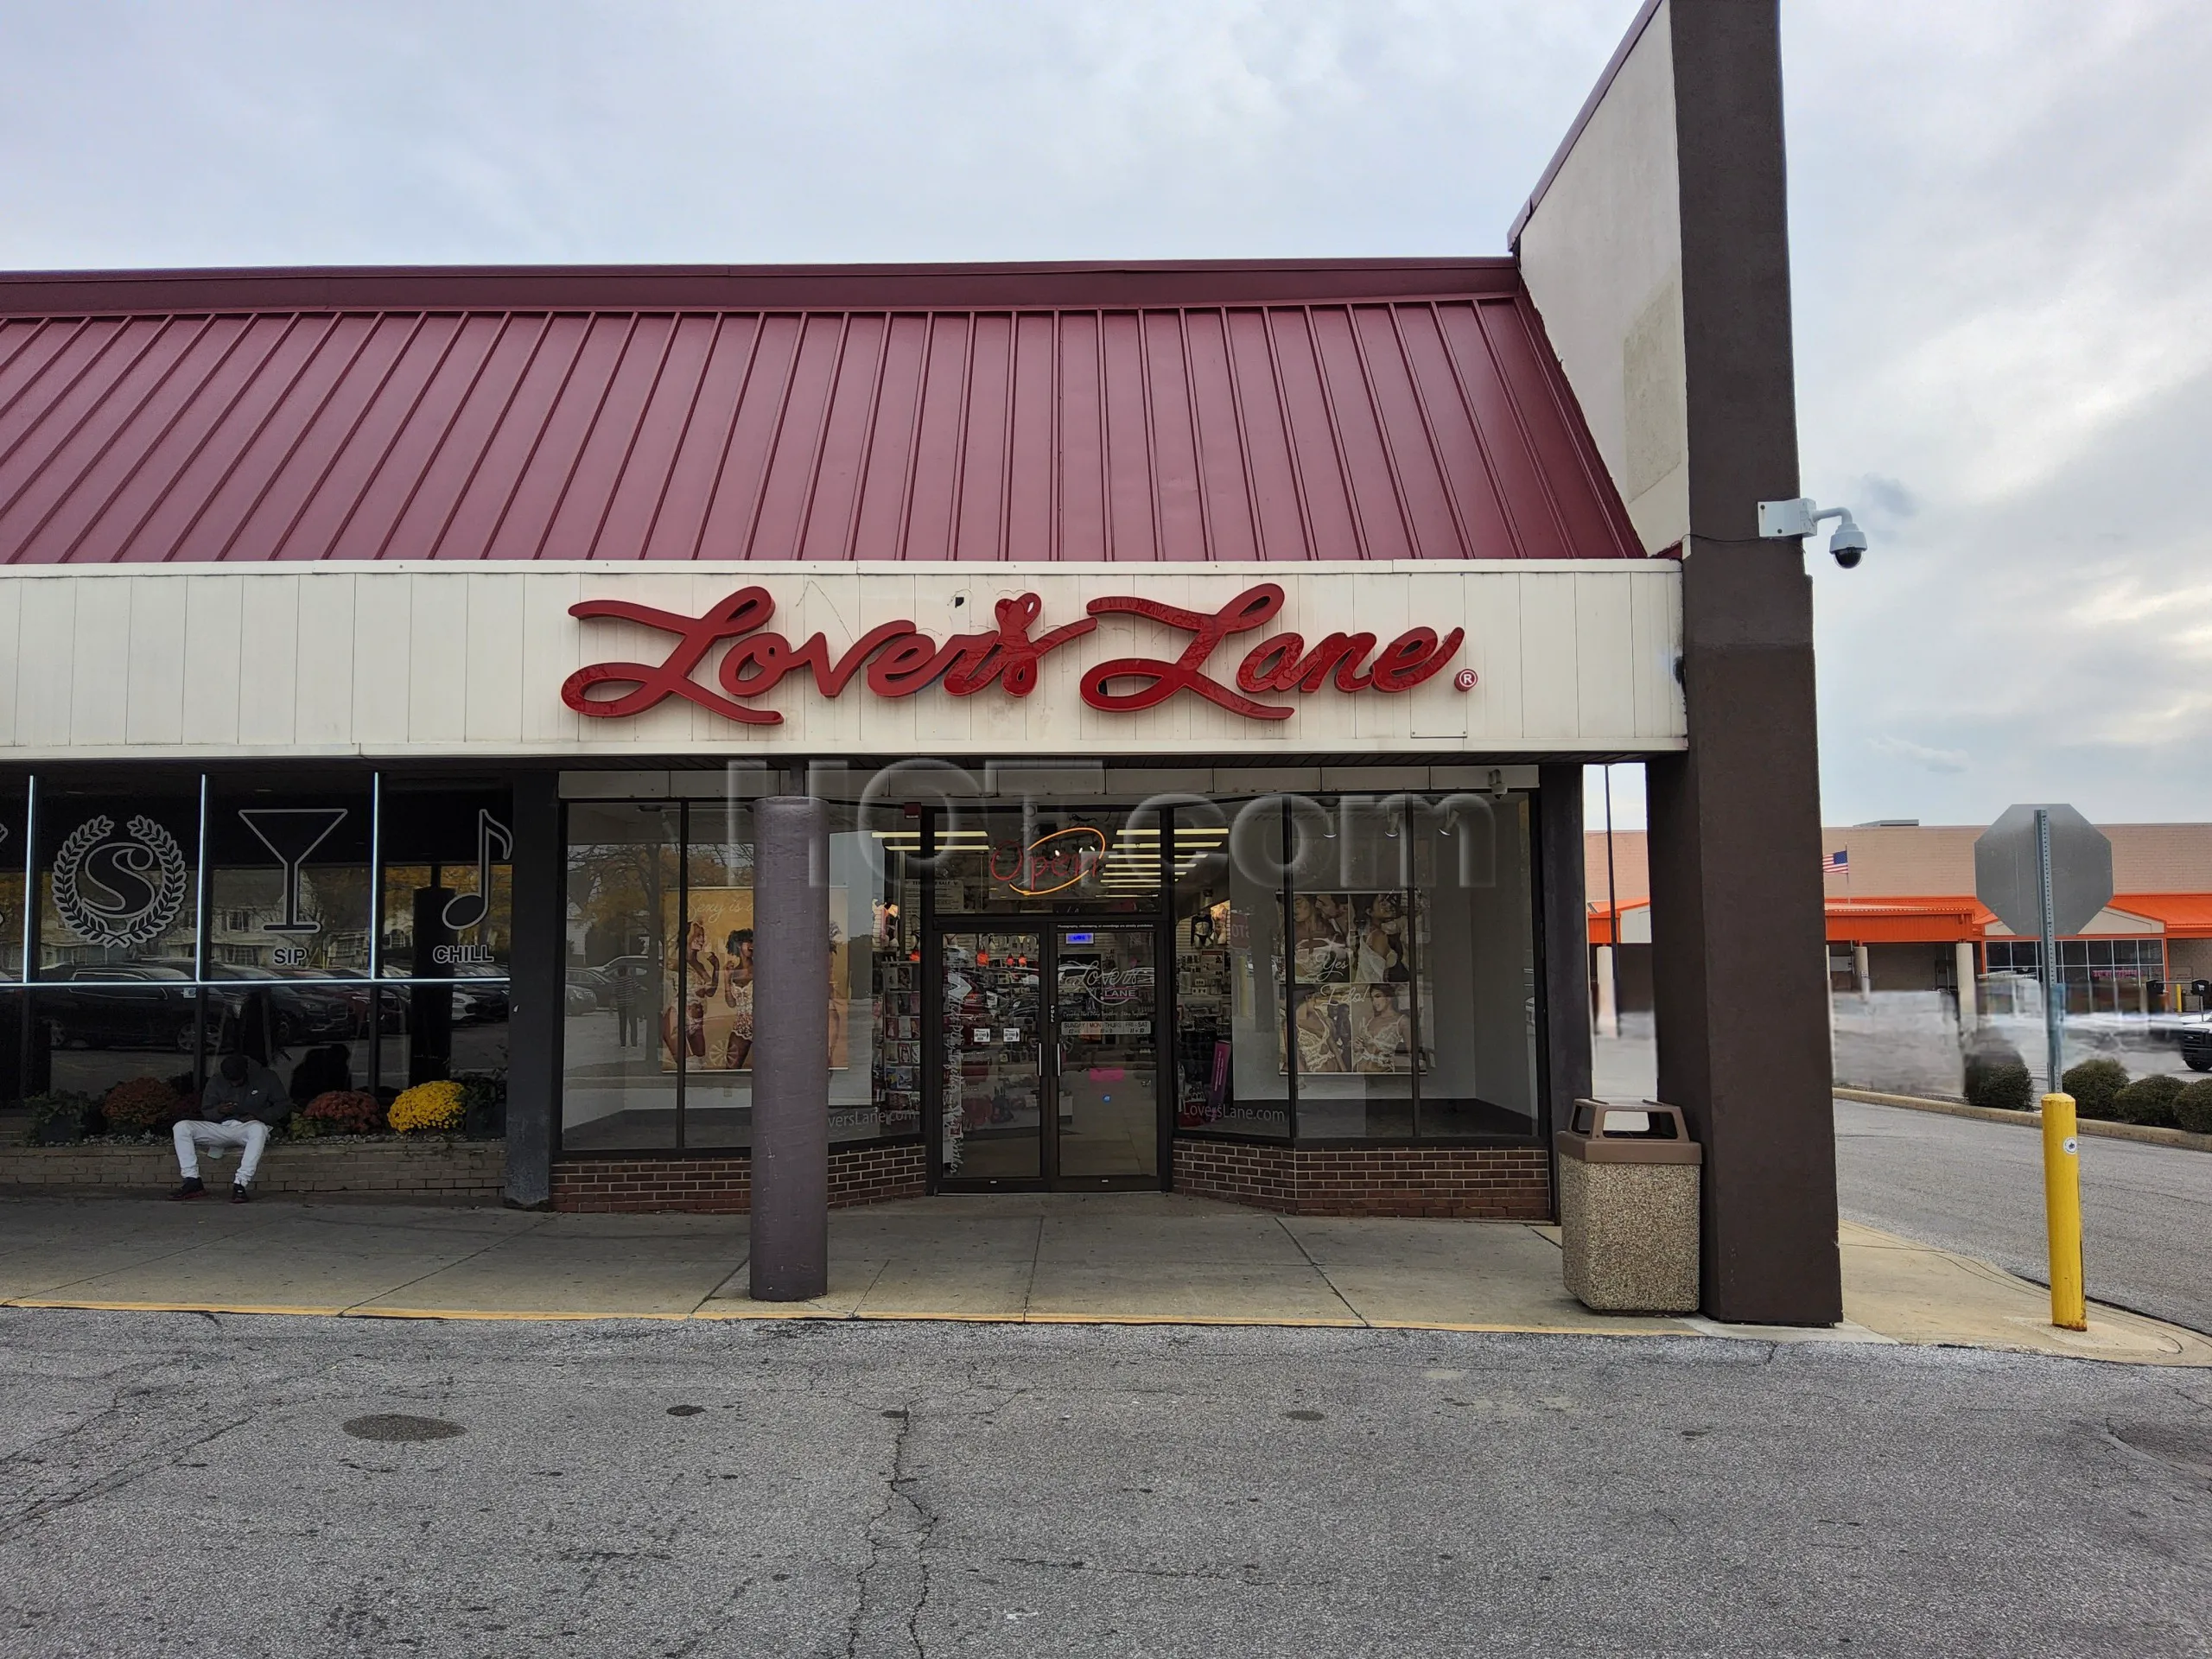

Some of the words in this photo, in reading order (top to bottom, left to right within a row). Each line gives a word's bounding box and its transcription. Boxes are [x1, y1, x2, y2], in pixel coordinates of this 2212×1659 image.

[1080, 582, 1465, 721] Lane
[81, 842, 156, 919] S
[991, 841, 1097, 892] Open
[688, 893, 723, 924] Sexy
[273, 946, 309, 965] SIP
[433, 944, 495, 964] CHILL
[1316, 950, 1348, 982] Yes
[828, 1110, 917, 1128] versLane.com
[1183, 1101, 1285, 1122] LoversLane.com
